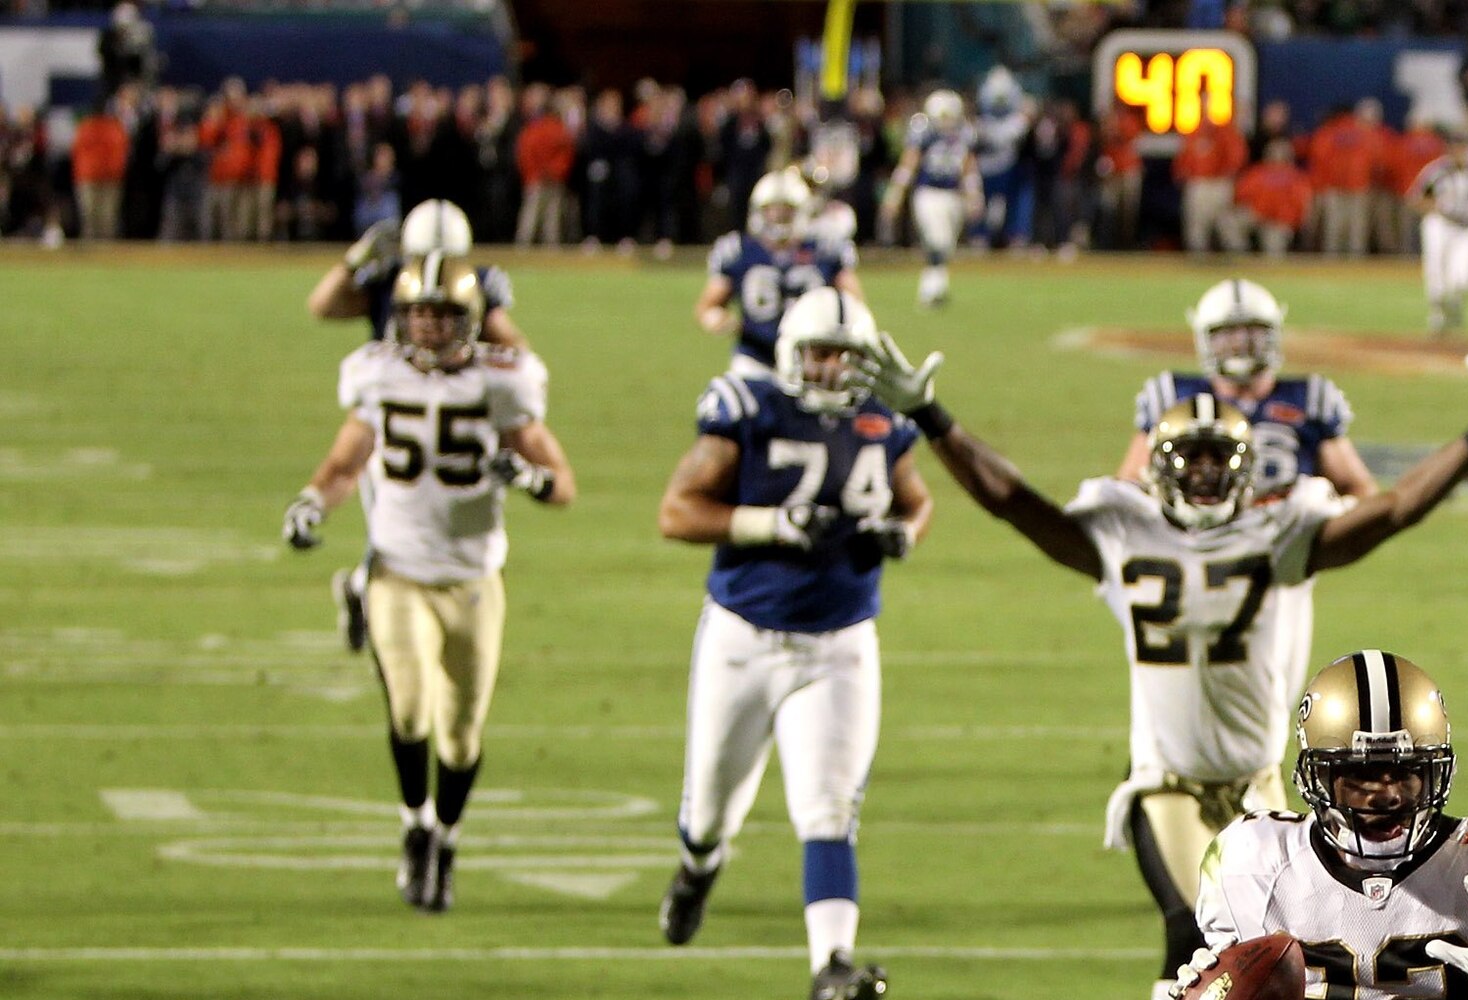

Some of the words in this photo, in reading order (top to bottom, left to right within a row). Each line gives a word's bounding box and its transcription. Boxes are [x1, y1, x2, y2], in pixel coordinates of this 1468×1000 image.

[1113, 48, 1234, 135] 40
[381, 401, 489, 486] 55
[767, 438, 894, 519] 74
[1121, 553, 1273, 666] 27
